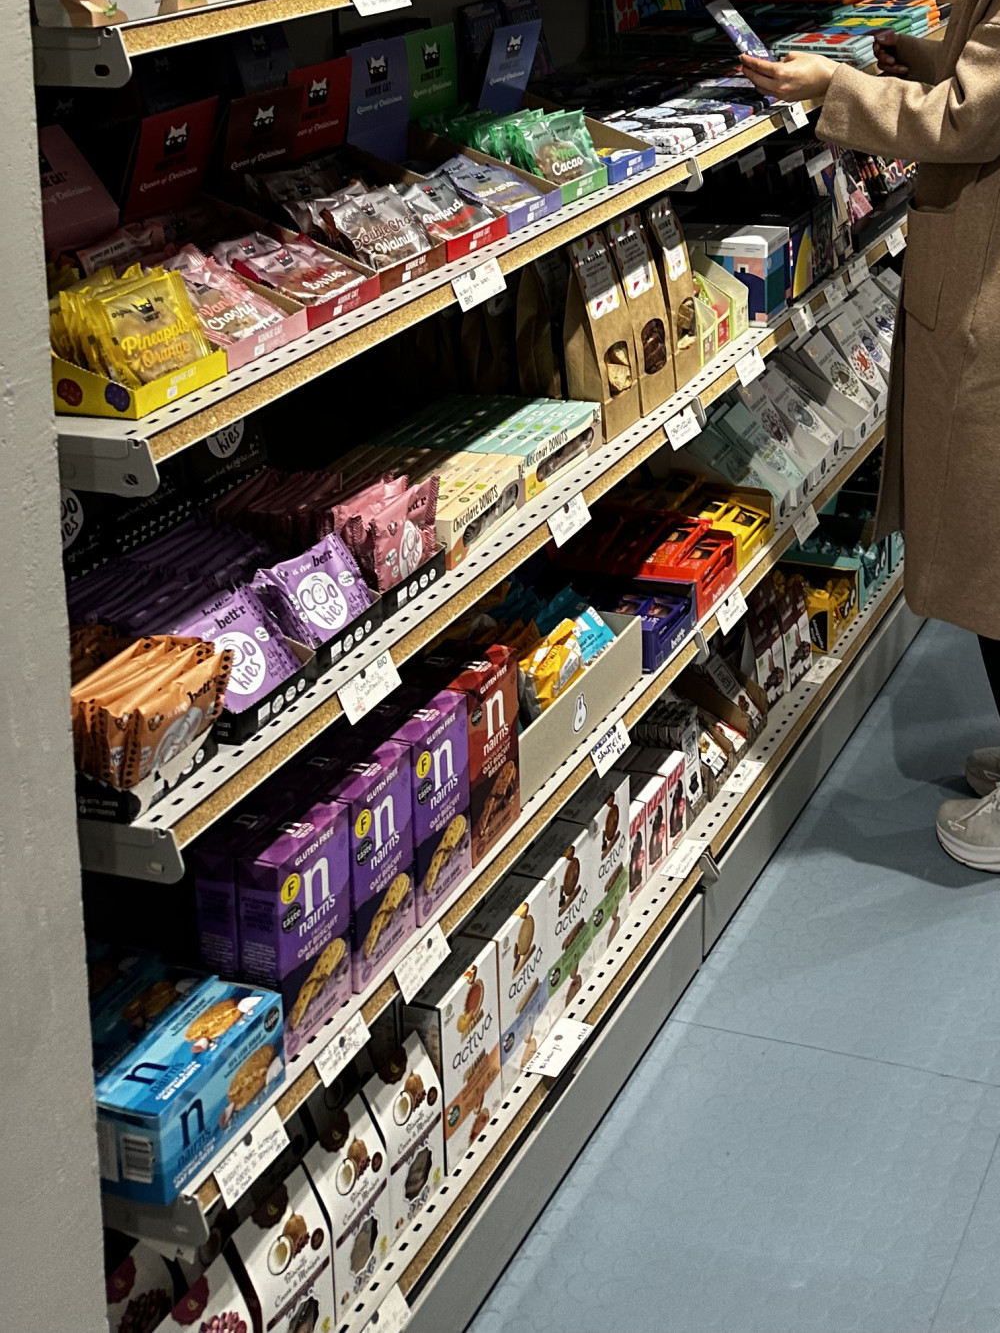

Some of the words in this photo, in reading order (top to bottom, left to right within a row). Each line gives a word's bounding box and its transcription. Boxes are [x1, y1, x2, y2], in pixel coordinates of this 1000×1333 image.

[551, 156, 584, 177] Cacao
[422, 196, 464, 224] Almond
[374, 228, 420, 255] Walnut
[121, 317, 191, 356] Pineapple
[548, 429, 569, 459] DONUTS
[452, 503, 479, 533] Chocolate
[479, 484, 499, 516] DONUTS
[318, 599, 342, 626] kies
[232, 658, 262, 691] kies
[426, 725, 444, 745] GLUTEN
[443, 712, 456, 730] FREE
[485, 687, 507, 740] n
[366, 777, 387, 803] GLUTEN
[386, 766, 399, 784] FREE
[432, 739, 455, 793] n
[430, 773, 459, 810] nairn's
[373, 794, 396, 852] n
[294, 840, 319, 867] GLUTEN
[319, 825, 335, 847] FREE
[370, 829, 400, 870] nairn's
[302, 856, 331, 918] n
[369, 873, 382, 891] OAT
[282, 908, 302, 929] taste
[298, 892, 336, 938] nairn's
[297, 939, 313, 959] OAT
[312, 913, 339, 945] BISCUIT
[305, 931, 333, 961] BREAKS
[508, 947, 544, 1001] activa
[451, 1010, 494, 1071] activa
[180, 1098, 206, 1150] n
